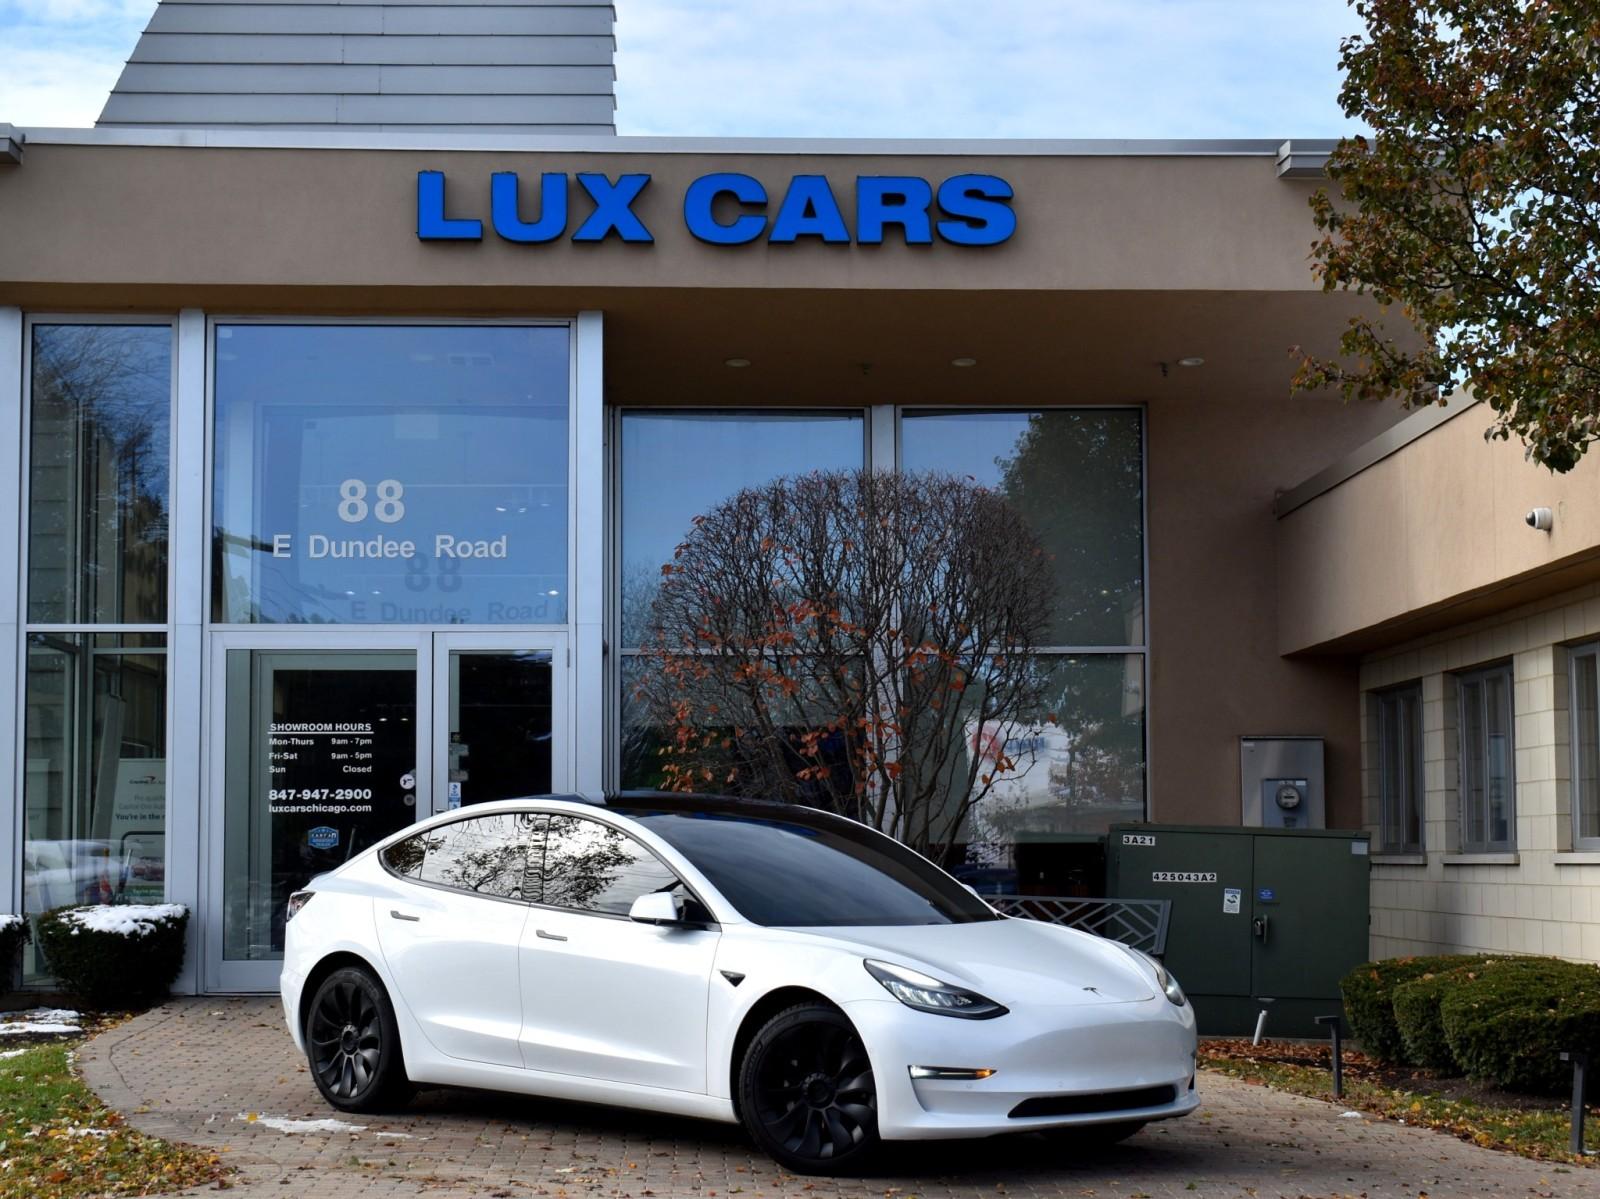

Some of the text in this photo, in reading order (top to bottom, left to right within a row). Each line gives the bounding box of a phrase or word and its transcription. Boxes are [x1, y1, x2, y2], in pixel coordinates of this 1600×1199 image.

[417, 171, 1017, 246] LUX CARS
[338, 479, 405, 523] 88
[273, 534, 507, 558] E Dundee Road
[270, 723, 372, 731] SHOWROOM HOURS
[355, 737, 372, 746] 7pm
[269, 752, 298, 760] Fri-Sat
[355, 752, 372, 760] 5pm
[343, 765, 372, 773] Closed
[269, 789, 372, 800] 847-947-2900
[269, 804, 372, 814] luxcarschicago.com
[1124, 836, 1153, 845] 3A21
[1153, 873, 1216, 882] 425043A2
